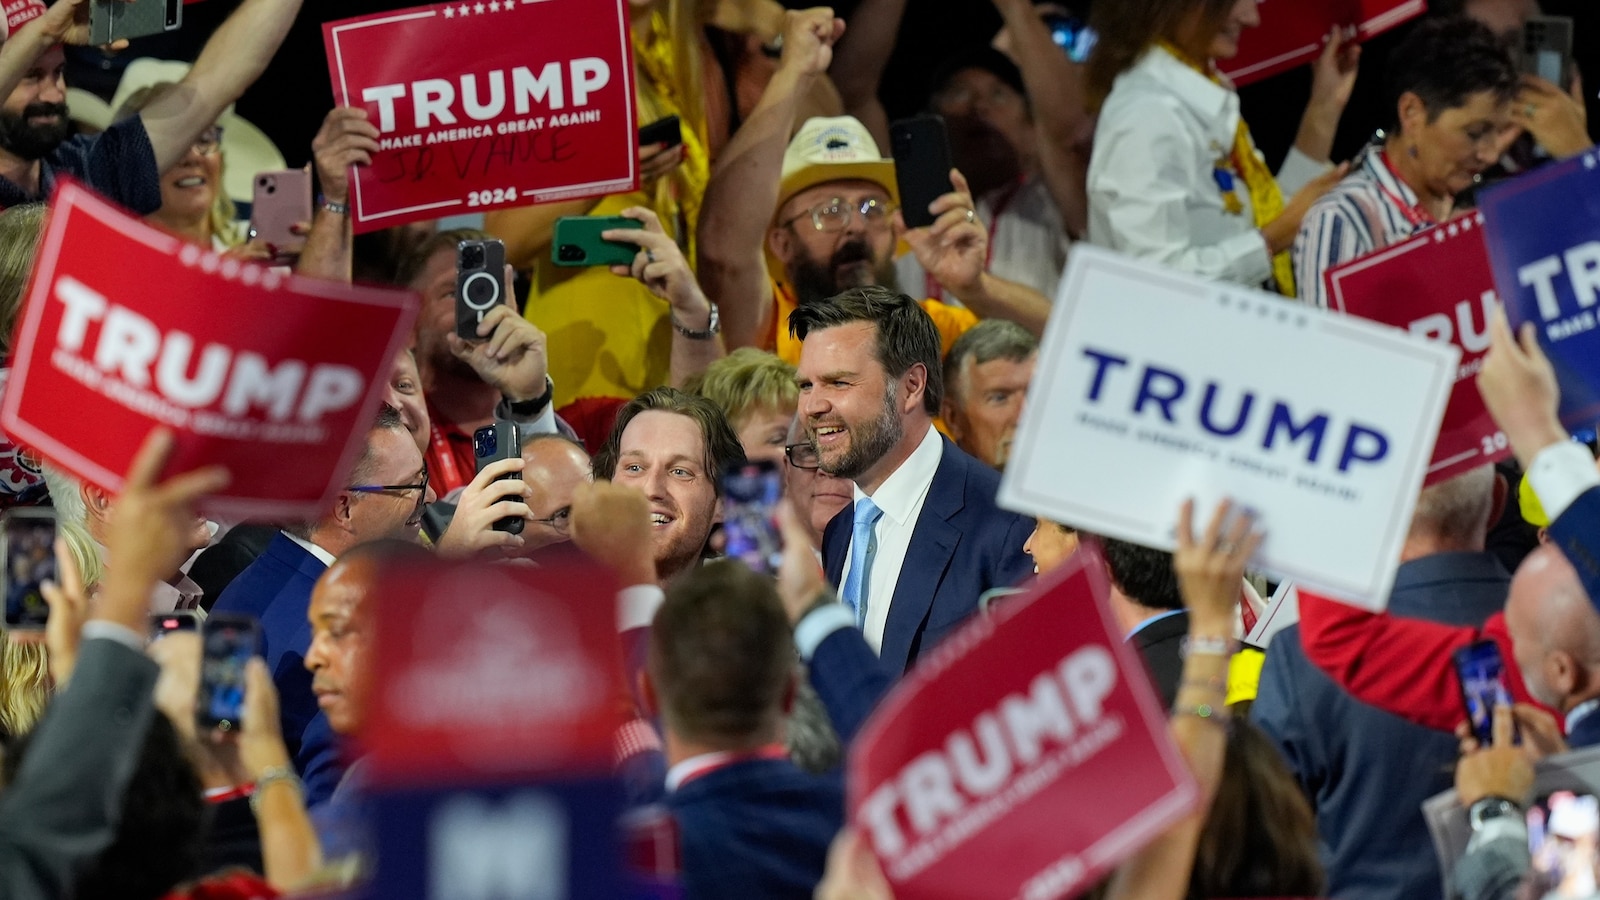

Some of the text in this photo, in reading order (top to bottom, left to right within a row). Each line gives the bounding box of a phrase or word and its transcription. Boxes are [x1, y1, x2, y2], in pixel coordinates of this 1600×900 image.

[6, 1, 26, 15] AKE
[362, 57, 611, 134] TRUMP
[380, 109, 601, 151] MAKE AMERICA GREAT AGAIN!
[451, 127, 577, 180] VANCE
[467, 187, 517, 207] 2024
[54, 274, 364, 421] TRUMP
[1082, 347, 1391, 474] TRUMP
[861, 646, 1117, 861] TRUMP
